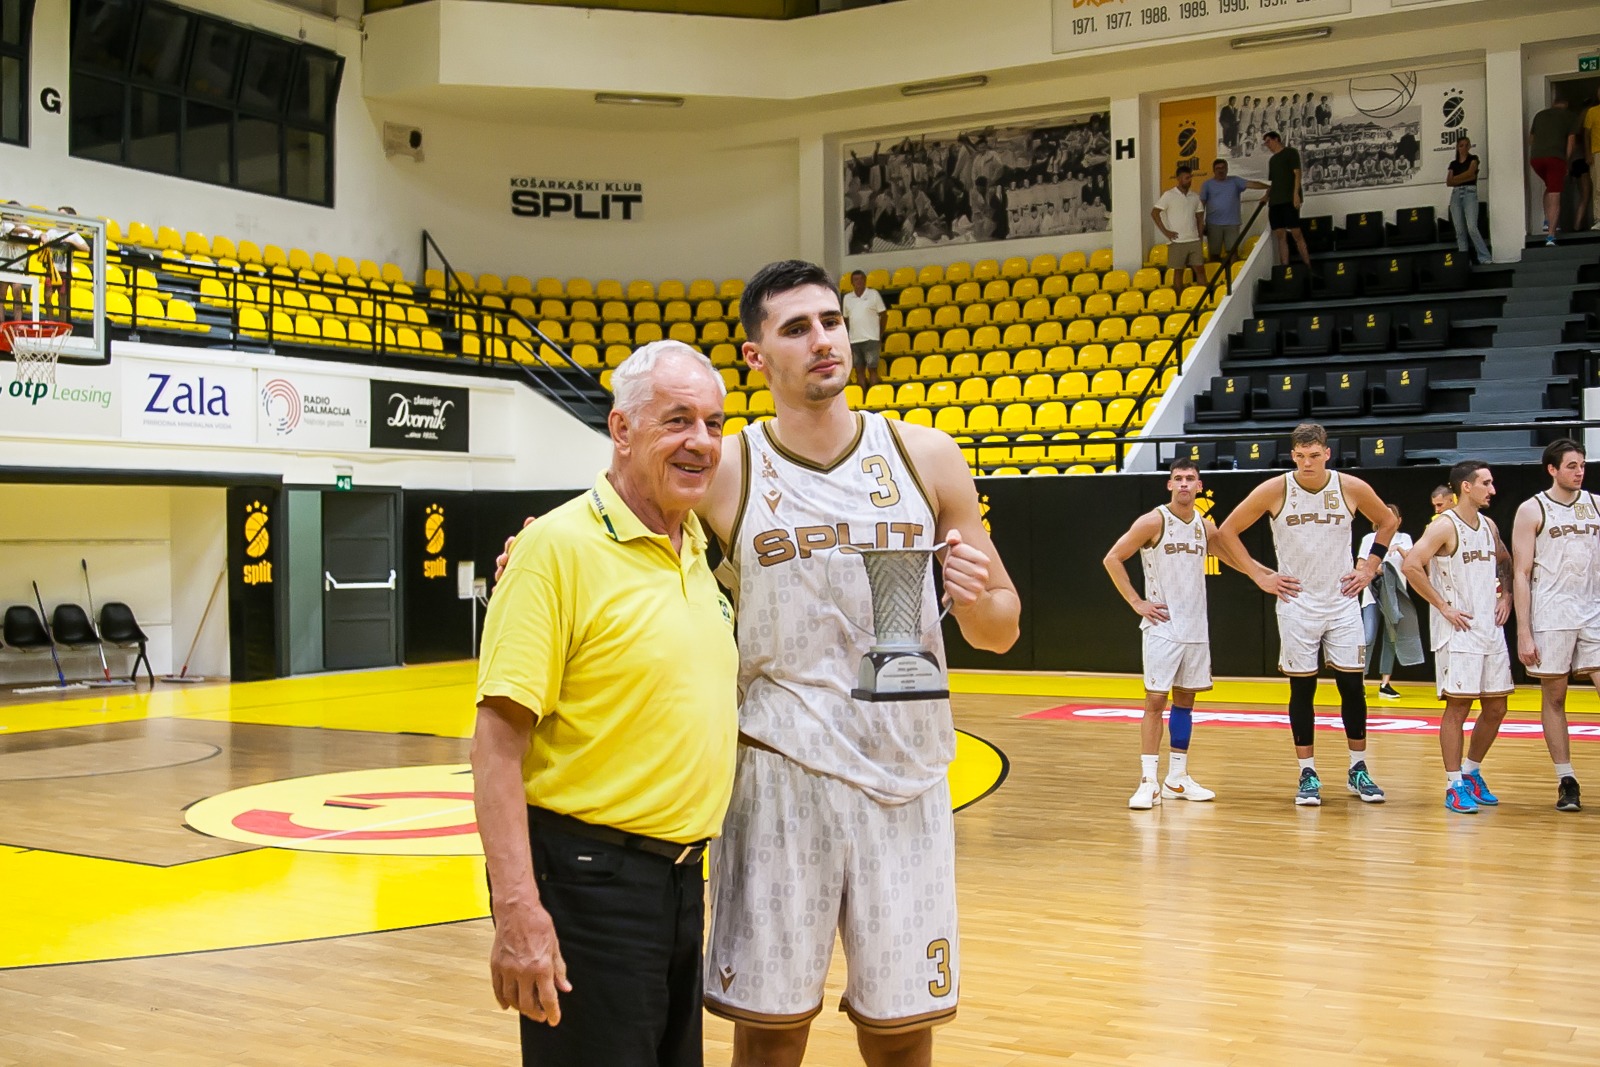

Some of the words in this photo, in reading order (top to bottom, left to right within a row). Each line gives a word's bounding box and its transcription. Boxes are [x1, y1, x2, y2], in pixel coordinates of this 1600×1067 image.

[1072, 17, 1098, 35] 1971.
[1106, 11, 1132, 30] 1977.
[1140, 6, 1170, 25] 1988.
[1179, 0, 1209, 19] 1989.
[40, 87, 61, 114] G
[1115, 137, 1135, 160] H
[510, 178, 600, 191] KOŠARKAŠKI
[605, 183, 642, 192] KLUB
[511, 189, 643, 220] SPLIT
[8, 378, 48, 405] otp
[52, 383, 112, 408] Leasing
[144, 373, 230, 416] Zala
[303, 395, 330, 405] RADIO
[303, 405, 351, 416] DALMACIJA
[386, 392, 455, 430] Dvornik
[861, 454, 901, 508] 3
[1323, 490, 1340, 509] 15
[1573, 502, 1596, 520] 80
[1286, 512, 1346, 527] SPLIT
[1549, 523, 1600, 539] SPLIT
[753, 522, 924, 568] SPLIT
[1164, 542, 1205, 557] SPLIT
[243, 559, 273, 585] split
[423, 556, 447, 579] split
[927, 938, 952, 998] 3
